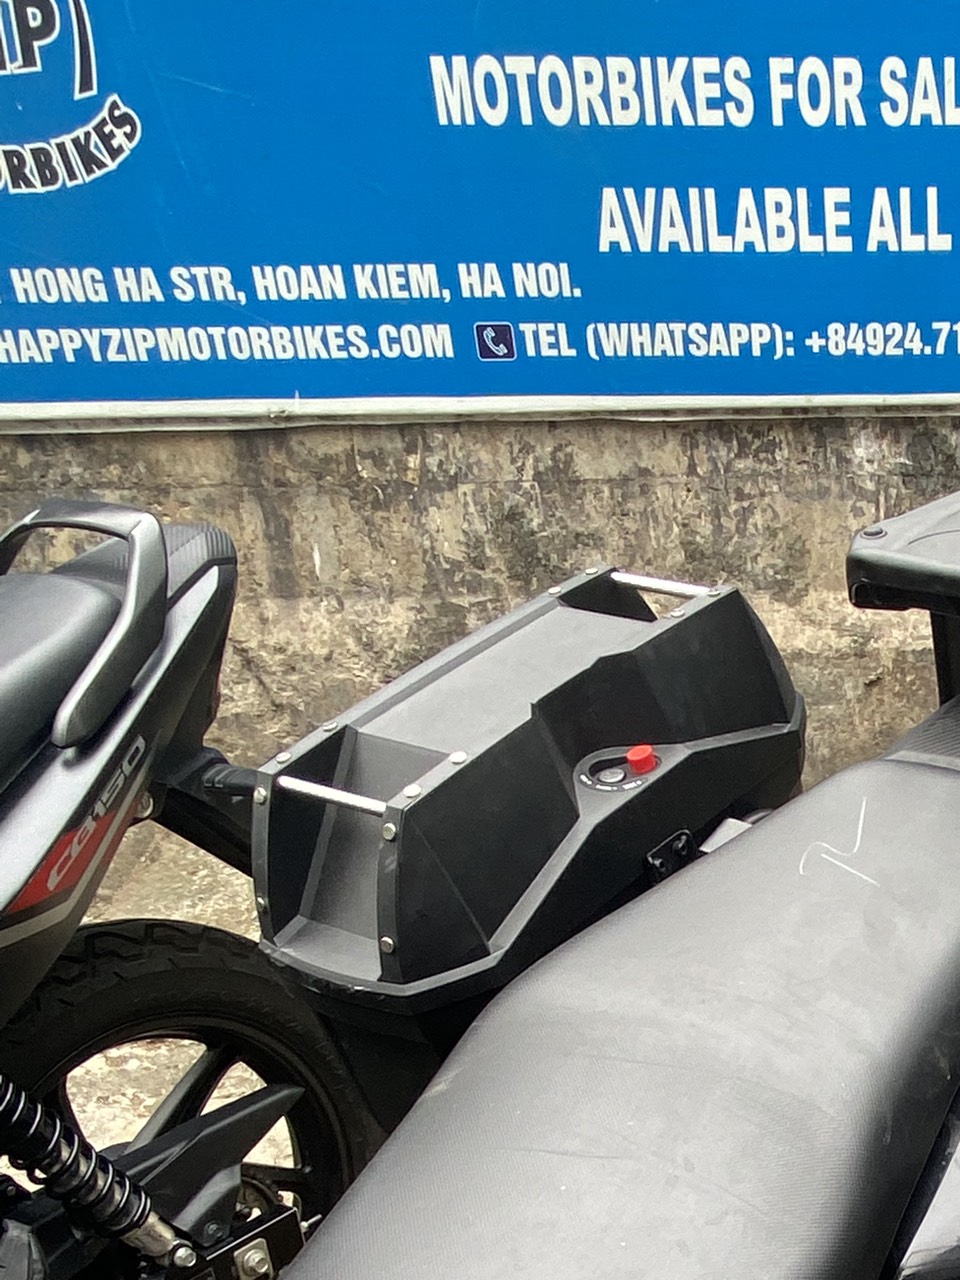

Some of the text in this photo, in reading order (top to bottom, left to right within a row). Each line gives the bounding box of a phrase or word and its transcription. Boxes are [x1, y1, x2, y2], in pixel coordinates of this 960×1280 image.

[430, 55, 754, 127] MOTORBIKES
[769, 56, 866, 127] FOR
[0, 95, 141, 193] RBIKES
[599, 188, 852, 252] AVAILABLE
[867, 187, 952, 251] ALL
[10, 263, 581, 305] HONG HA STR, HOAN KIEM, HA NOI.
[519, 323, 576, 356] TEL
[587, 323, 794, 360] (WHATSAPP):
